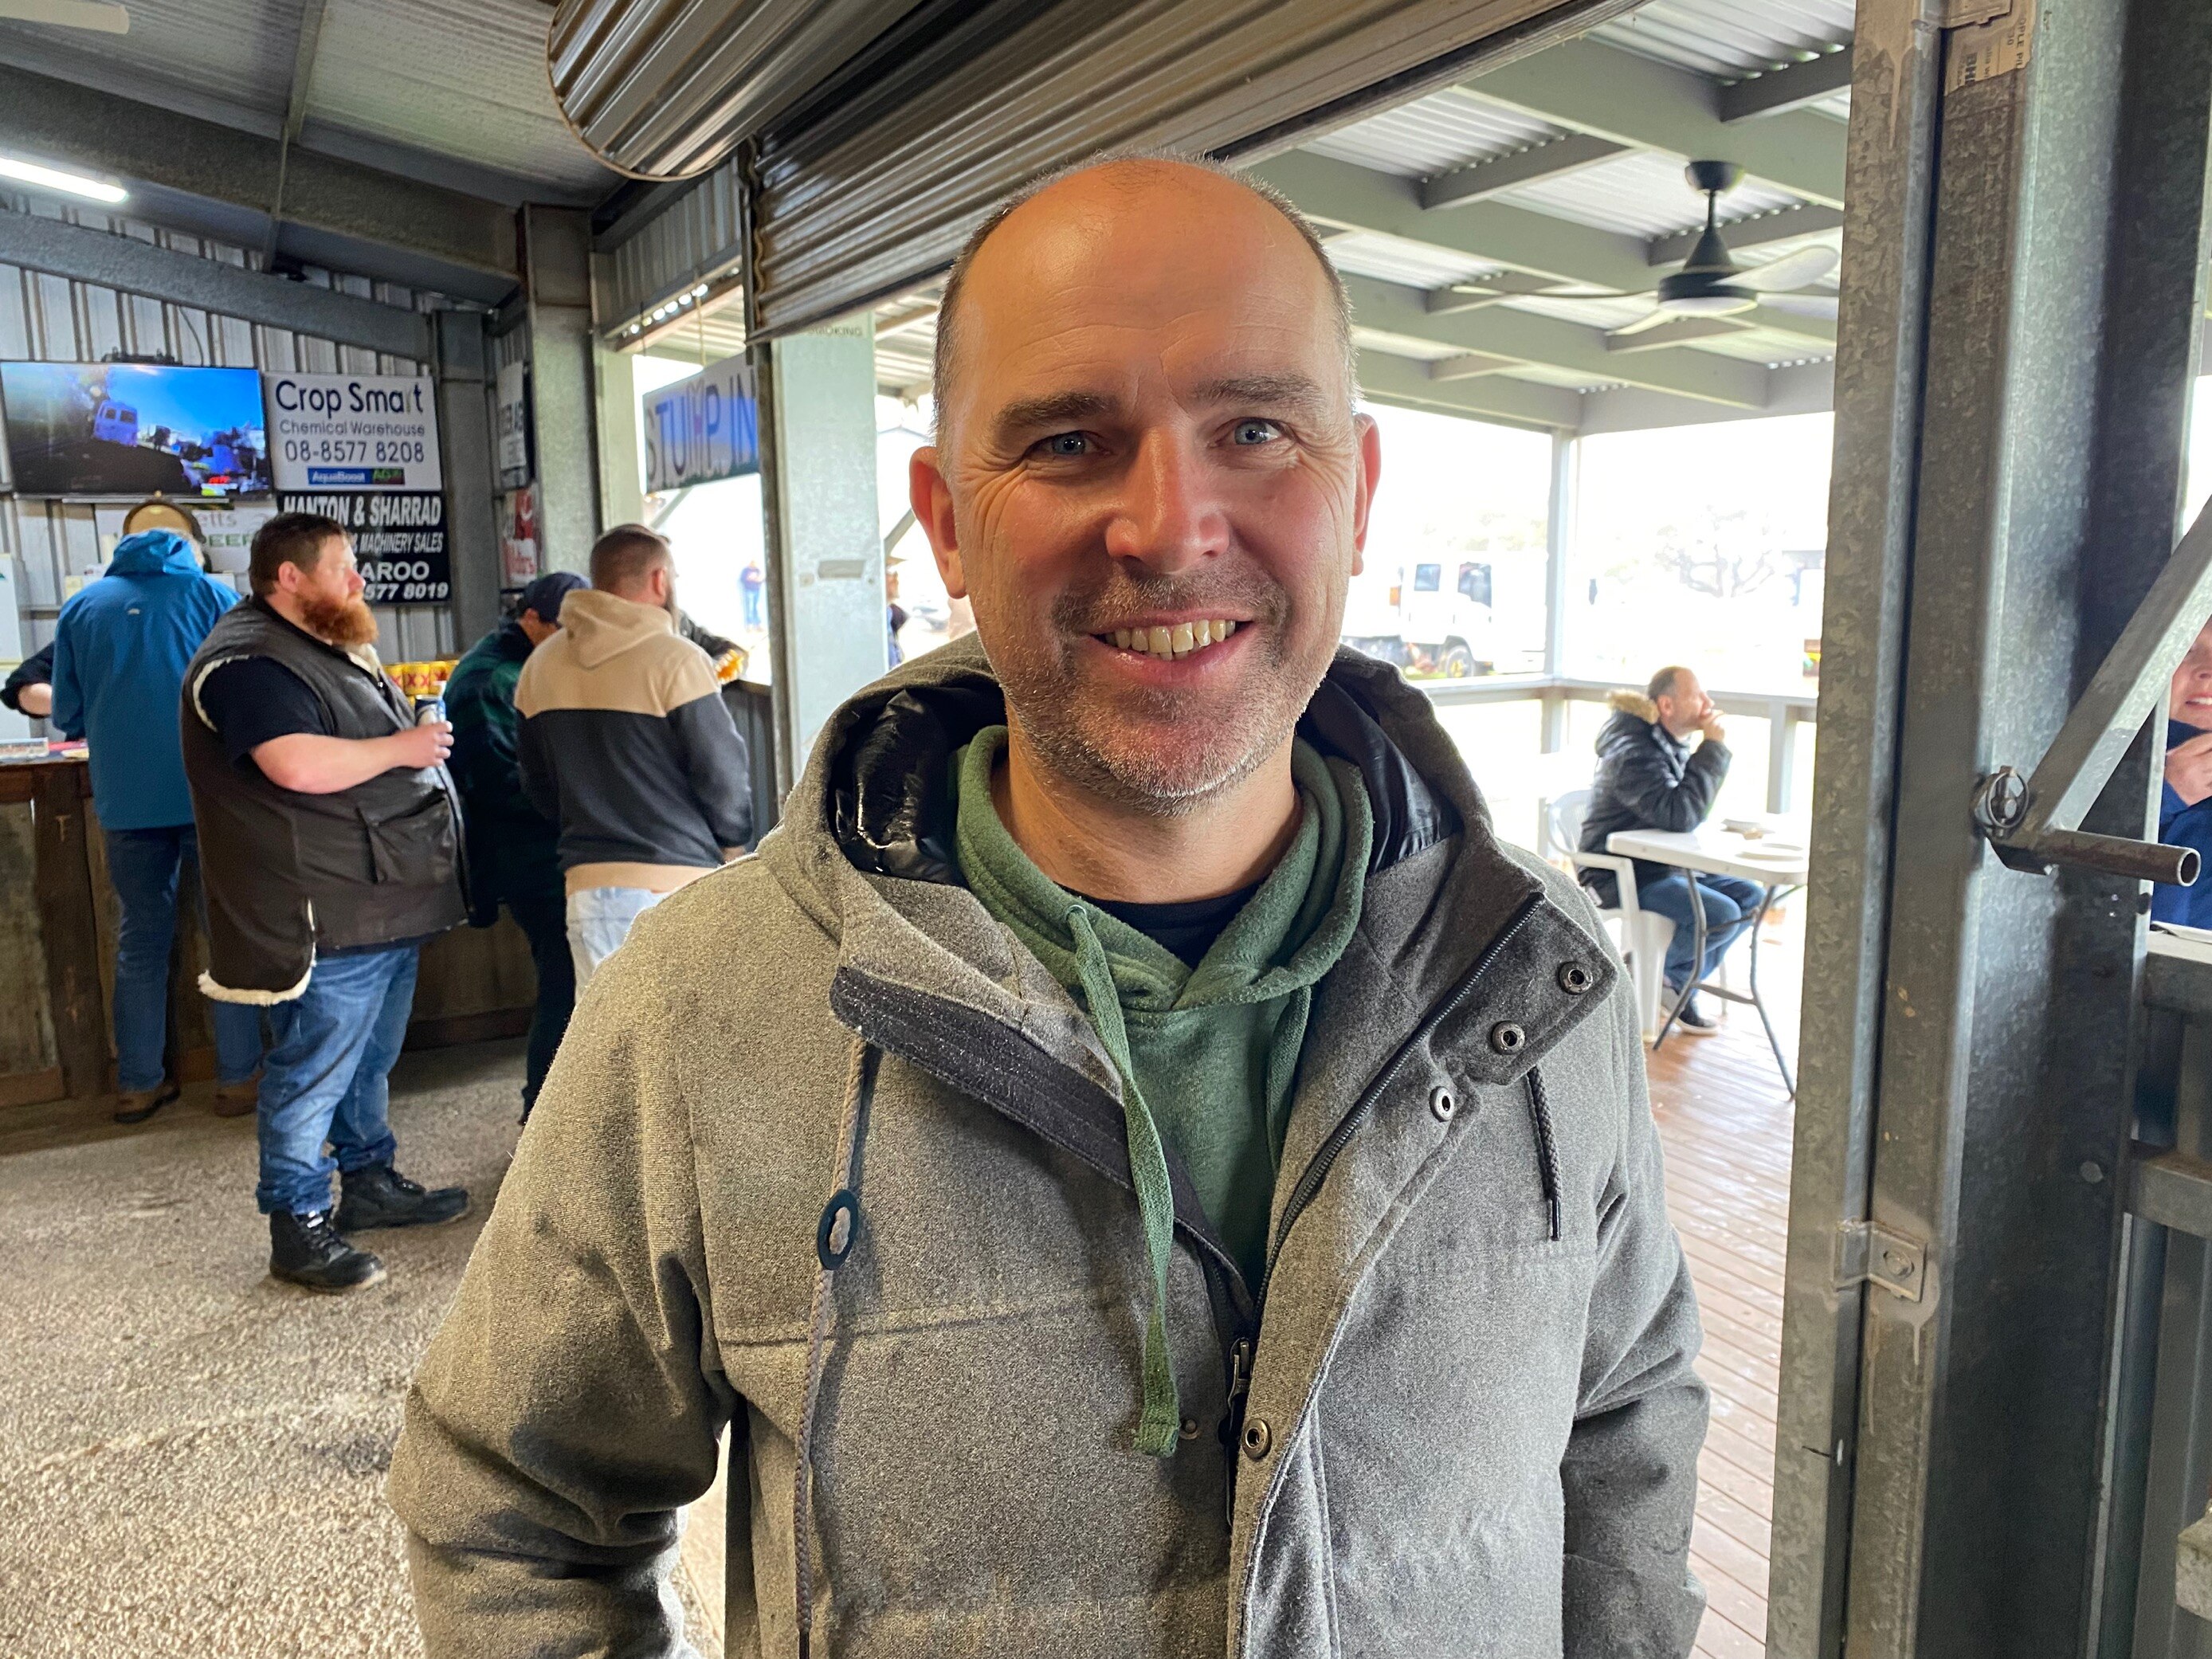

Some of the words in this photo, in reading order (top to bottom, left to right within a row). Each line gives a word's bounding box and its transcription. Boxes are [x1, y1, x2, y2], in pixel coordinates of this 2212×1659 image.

[276, 380, 342, 420] Crop
[279, 419, 347, 435] Chemical
[350, 421, 426, 437] Warehouse
[284, 440, 367, 463] 08-8577
[375, 441, 425, 463] 8208
[353, 496, 365, 526] &
[370, 496, 441, 527] SHARRAD
[359, 532, 414, 555] MACHINERY
[414, 531, 444, 553] SALES
[355, 560, 429, 581] AROO
[364, 582, 400, 600] 577
[403, 582, 449, 600] 8019
